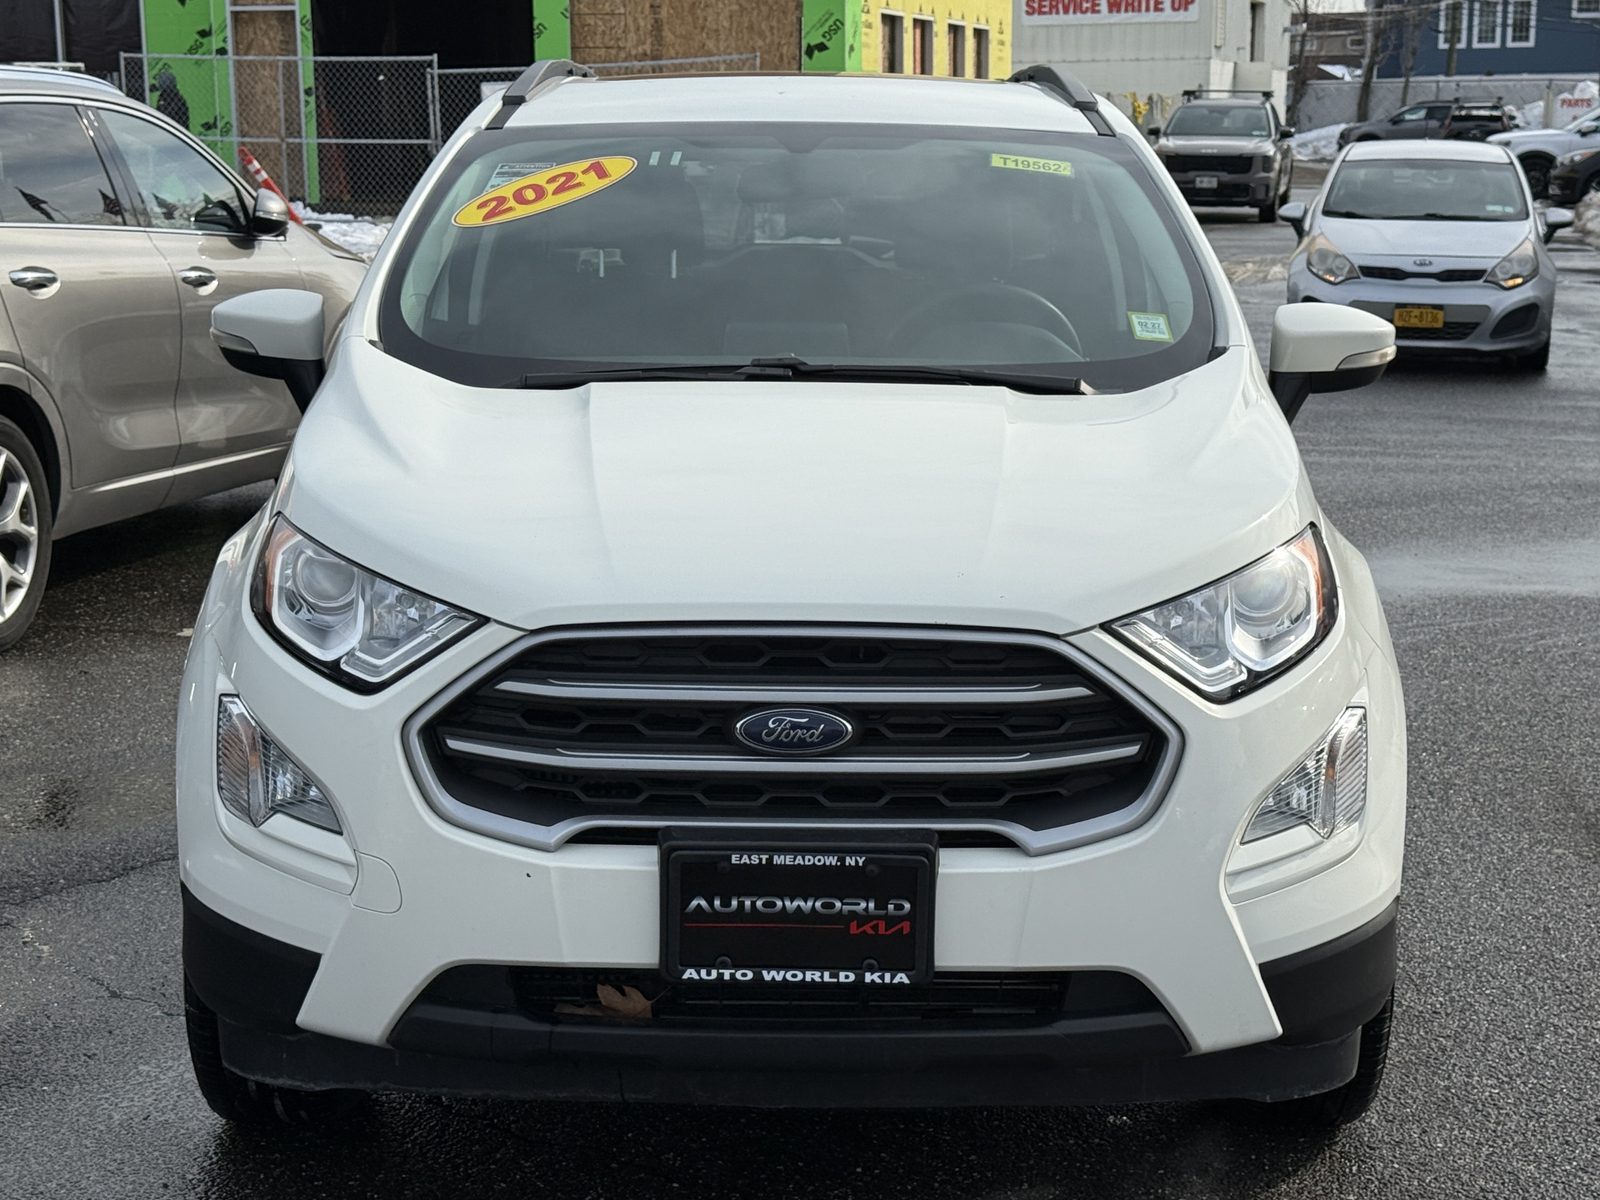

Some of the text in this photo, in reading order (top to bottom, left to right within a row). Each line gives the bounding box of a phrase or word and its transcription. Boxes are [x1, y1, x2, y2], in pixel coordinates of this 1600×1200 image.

[1025, 0, 1196, 16] SERVICE WRITE UP
[821, 18, 845, 42] USG
[1560, 98, 1592, 108] PARTS
[476, 160, 612, 222] 2021
[761, 716, 825, 743] Ford
[731, 854, 769, 865] EAST
[845, 856, 866, 867] NY
[684, 896, 912, 916] AUTOWORLD
[849, 920, 911, 935] KIA
[681, 968, 911, 984] AUTO WORLD KIA
